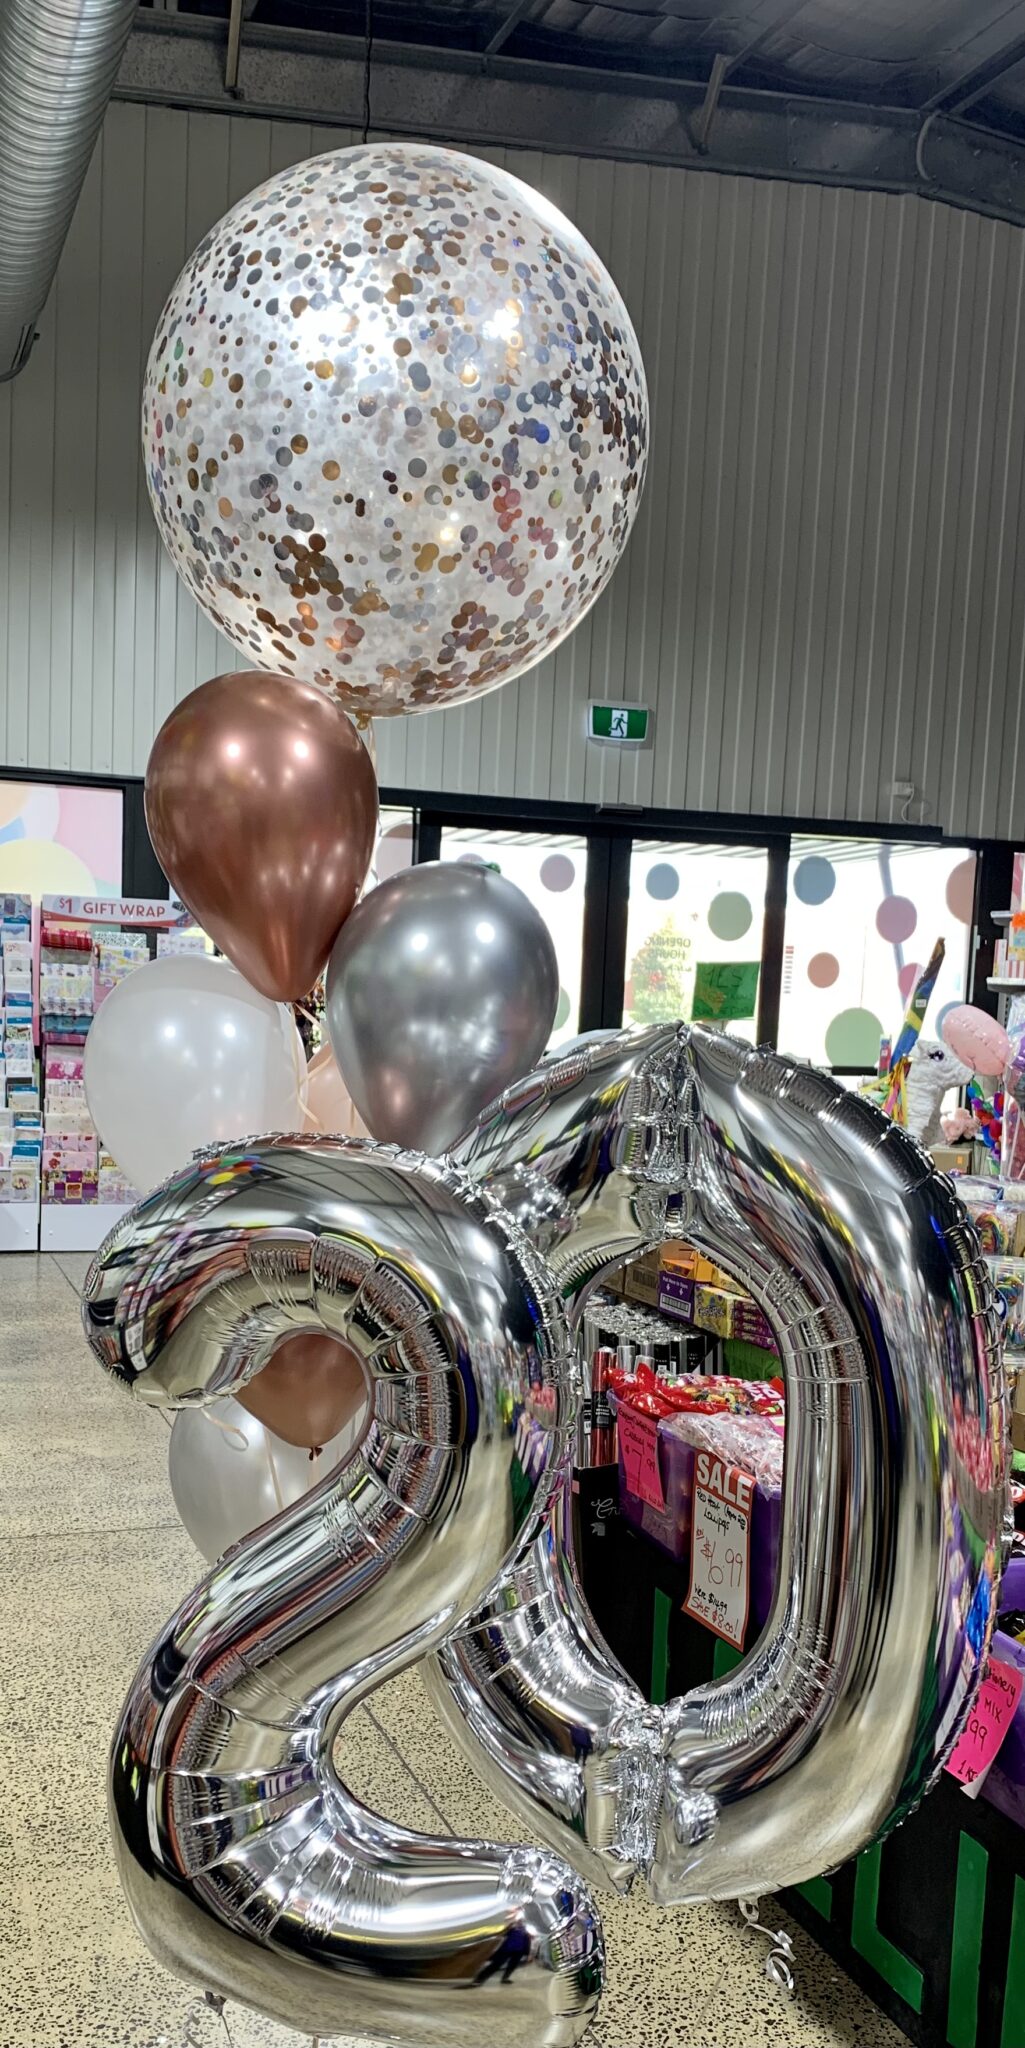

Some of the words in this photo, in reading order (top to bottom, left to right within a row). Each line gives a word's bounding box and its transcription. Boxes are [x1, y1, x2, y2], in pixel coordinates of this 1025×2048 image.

[59, 898, 73, 914] $1
[83, 902, 116, 916] GIFT
[119, 903, 165, 918] WRAP
[696, 1453, 753, 1511] SALE
[984, 1697, 1002, 1724] MIX
